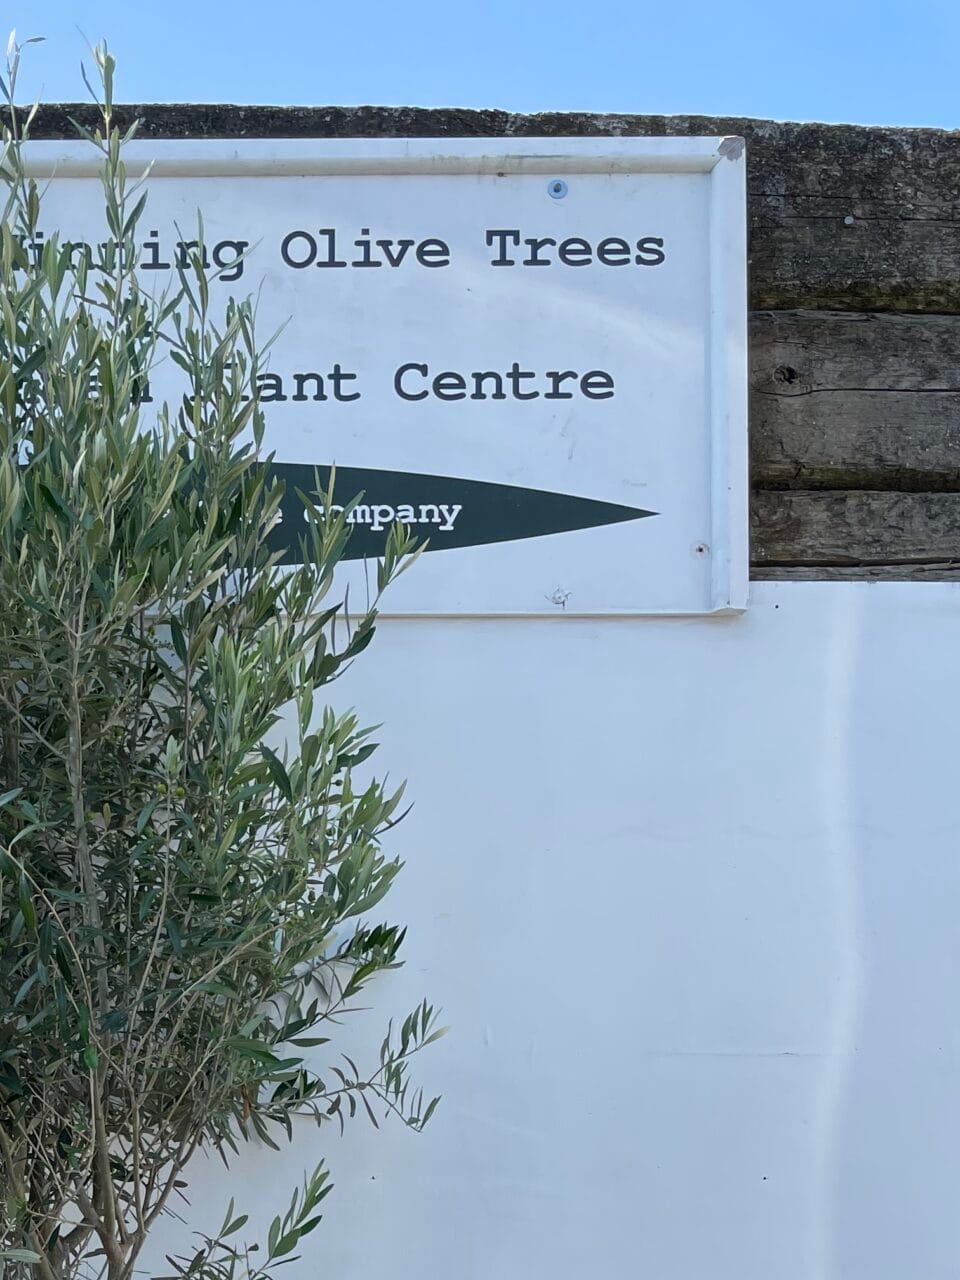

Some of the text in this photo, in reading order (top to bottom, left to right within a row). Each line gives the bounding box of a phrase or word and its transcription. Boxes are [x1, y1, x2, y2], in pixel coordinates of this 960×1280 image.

[281, 228, 451, 268] Olive
[486, 229, 665, 267] Trees
[394, 361, 615, 402] Centre
